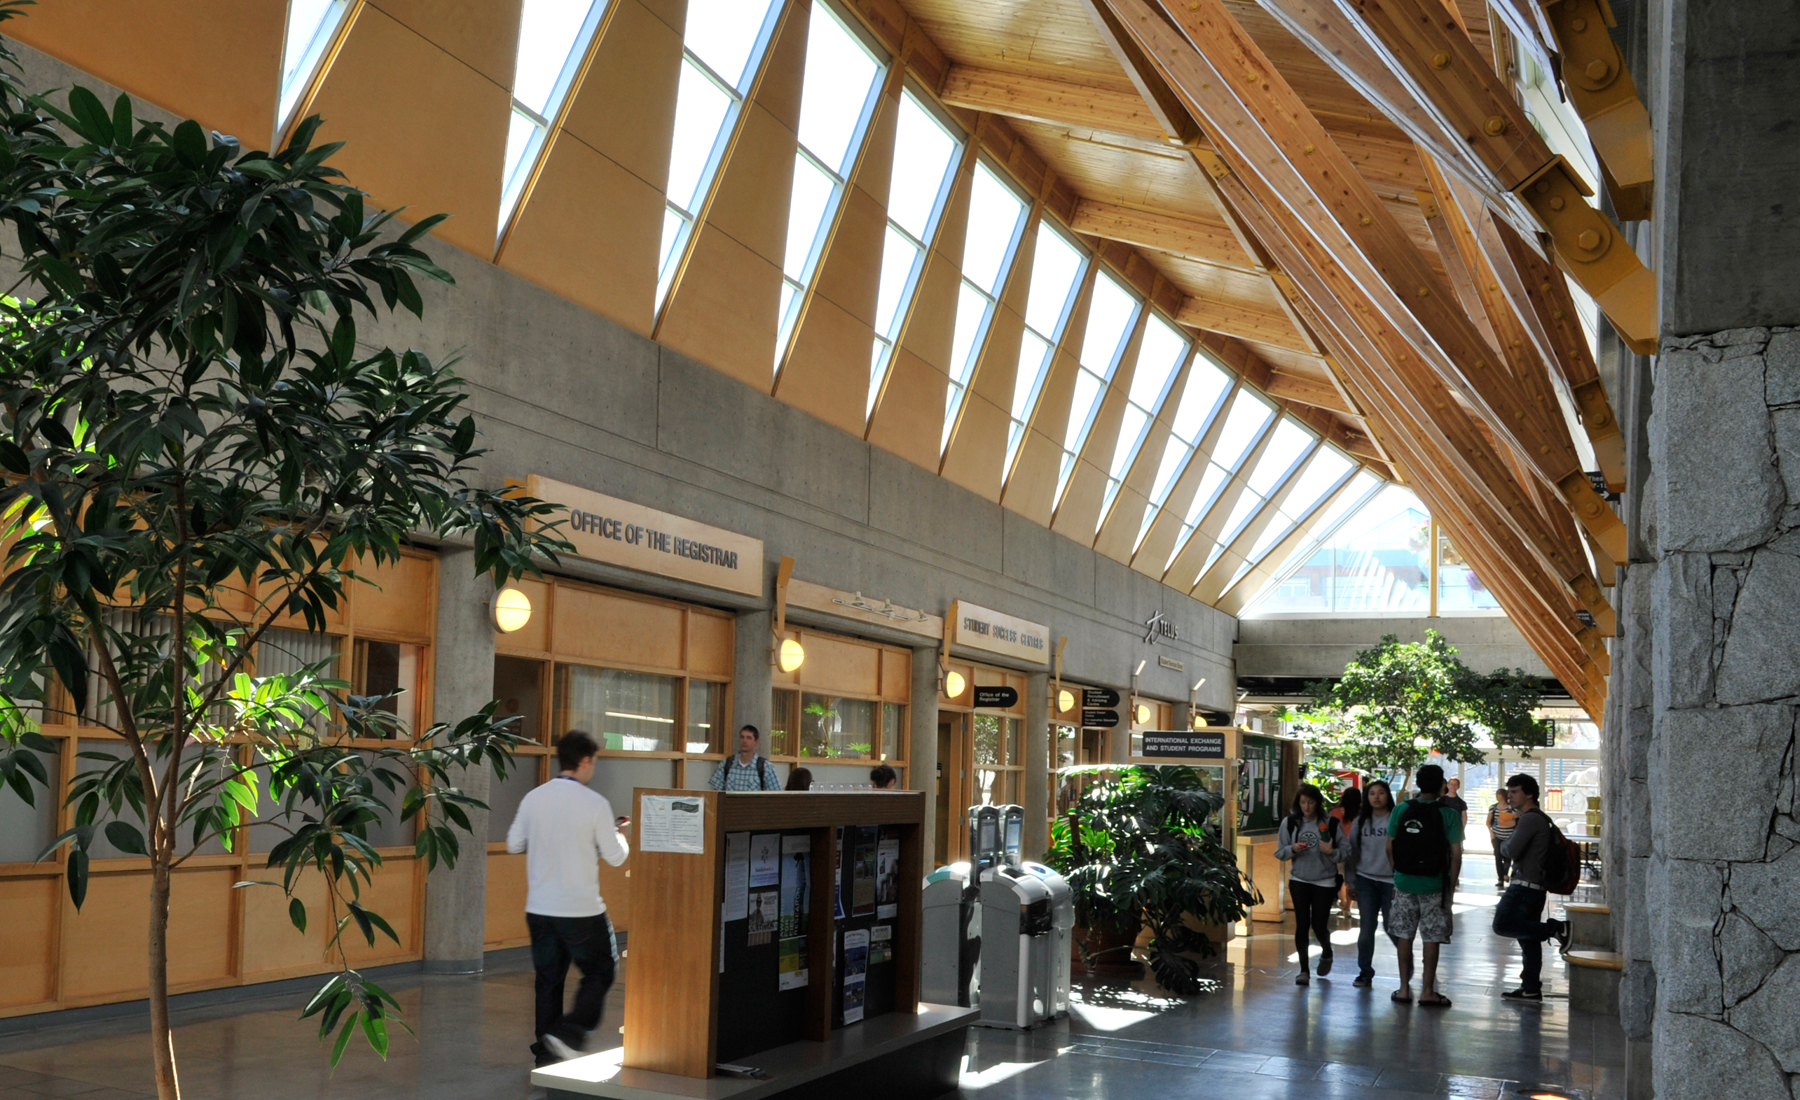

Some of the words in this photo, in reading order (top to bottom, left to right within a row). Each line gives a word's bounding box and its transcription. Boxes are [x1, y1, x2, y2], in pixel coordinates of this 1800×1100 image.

[571, 508, 622, 541] OFFICE
[625, 523, 644, 545] OF
[646, 528, 671, 553] THE
[673, 536, 738, 570] REGISTRAR
[963, 616, 990, 635] STUDENT
[993, 624, 1017, 643] SUCCESS
[1159, 619, 1179, 640] TELUS
